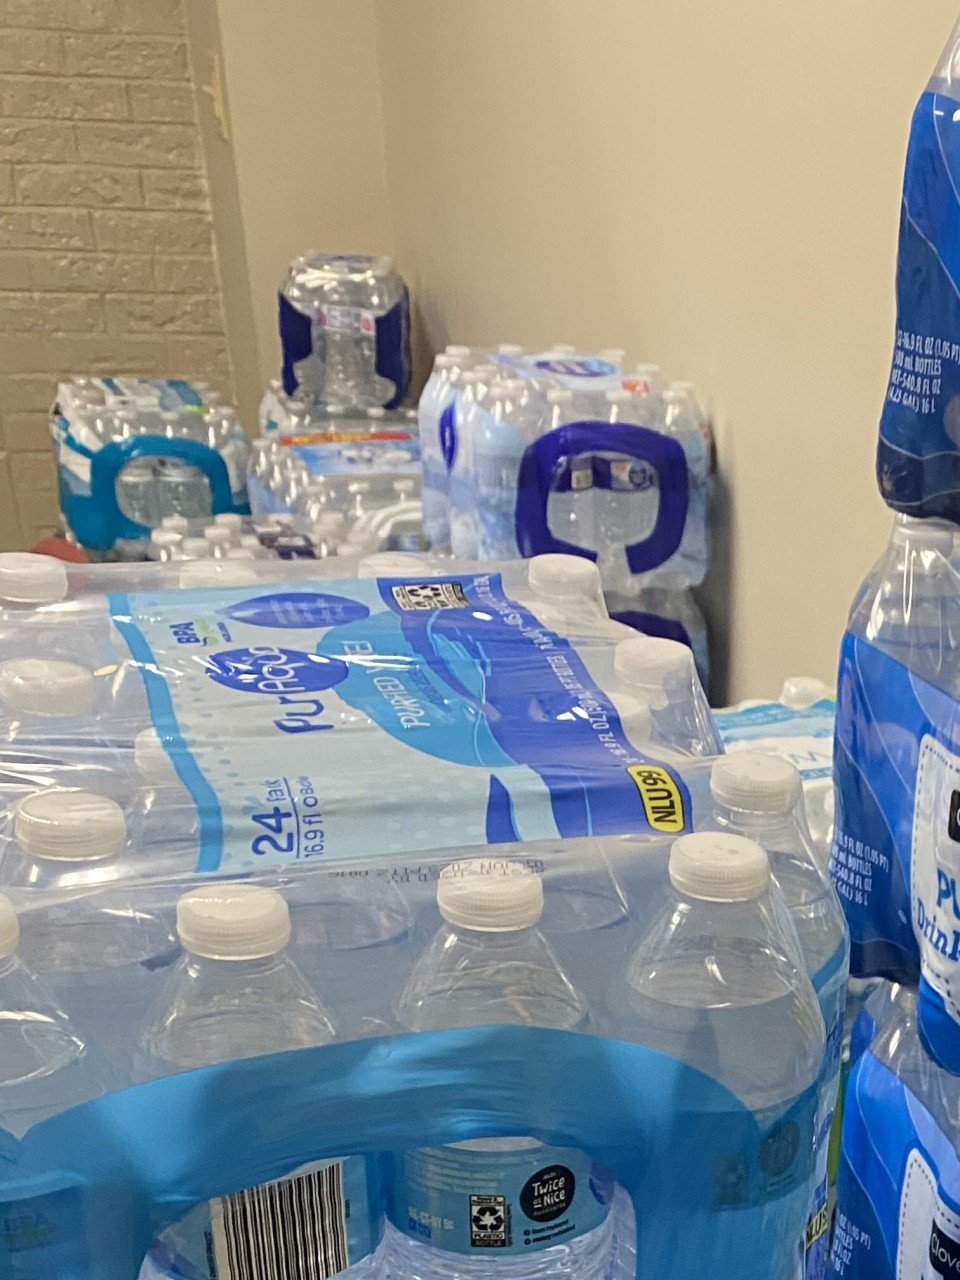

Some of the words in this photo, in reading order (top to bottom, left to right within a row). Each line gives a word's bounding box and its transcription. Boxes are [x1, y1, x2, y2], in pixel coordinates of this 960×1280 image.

[251, 806, 294, 856] 24
[304, 829, 325, 858] 16.9
[532, 1177, 566, 1196] Twice
[543, 1190, 566, 1206] Nice
